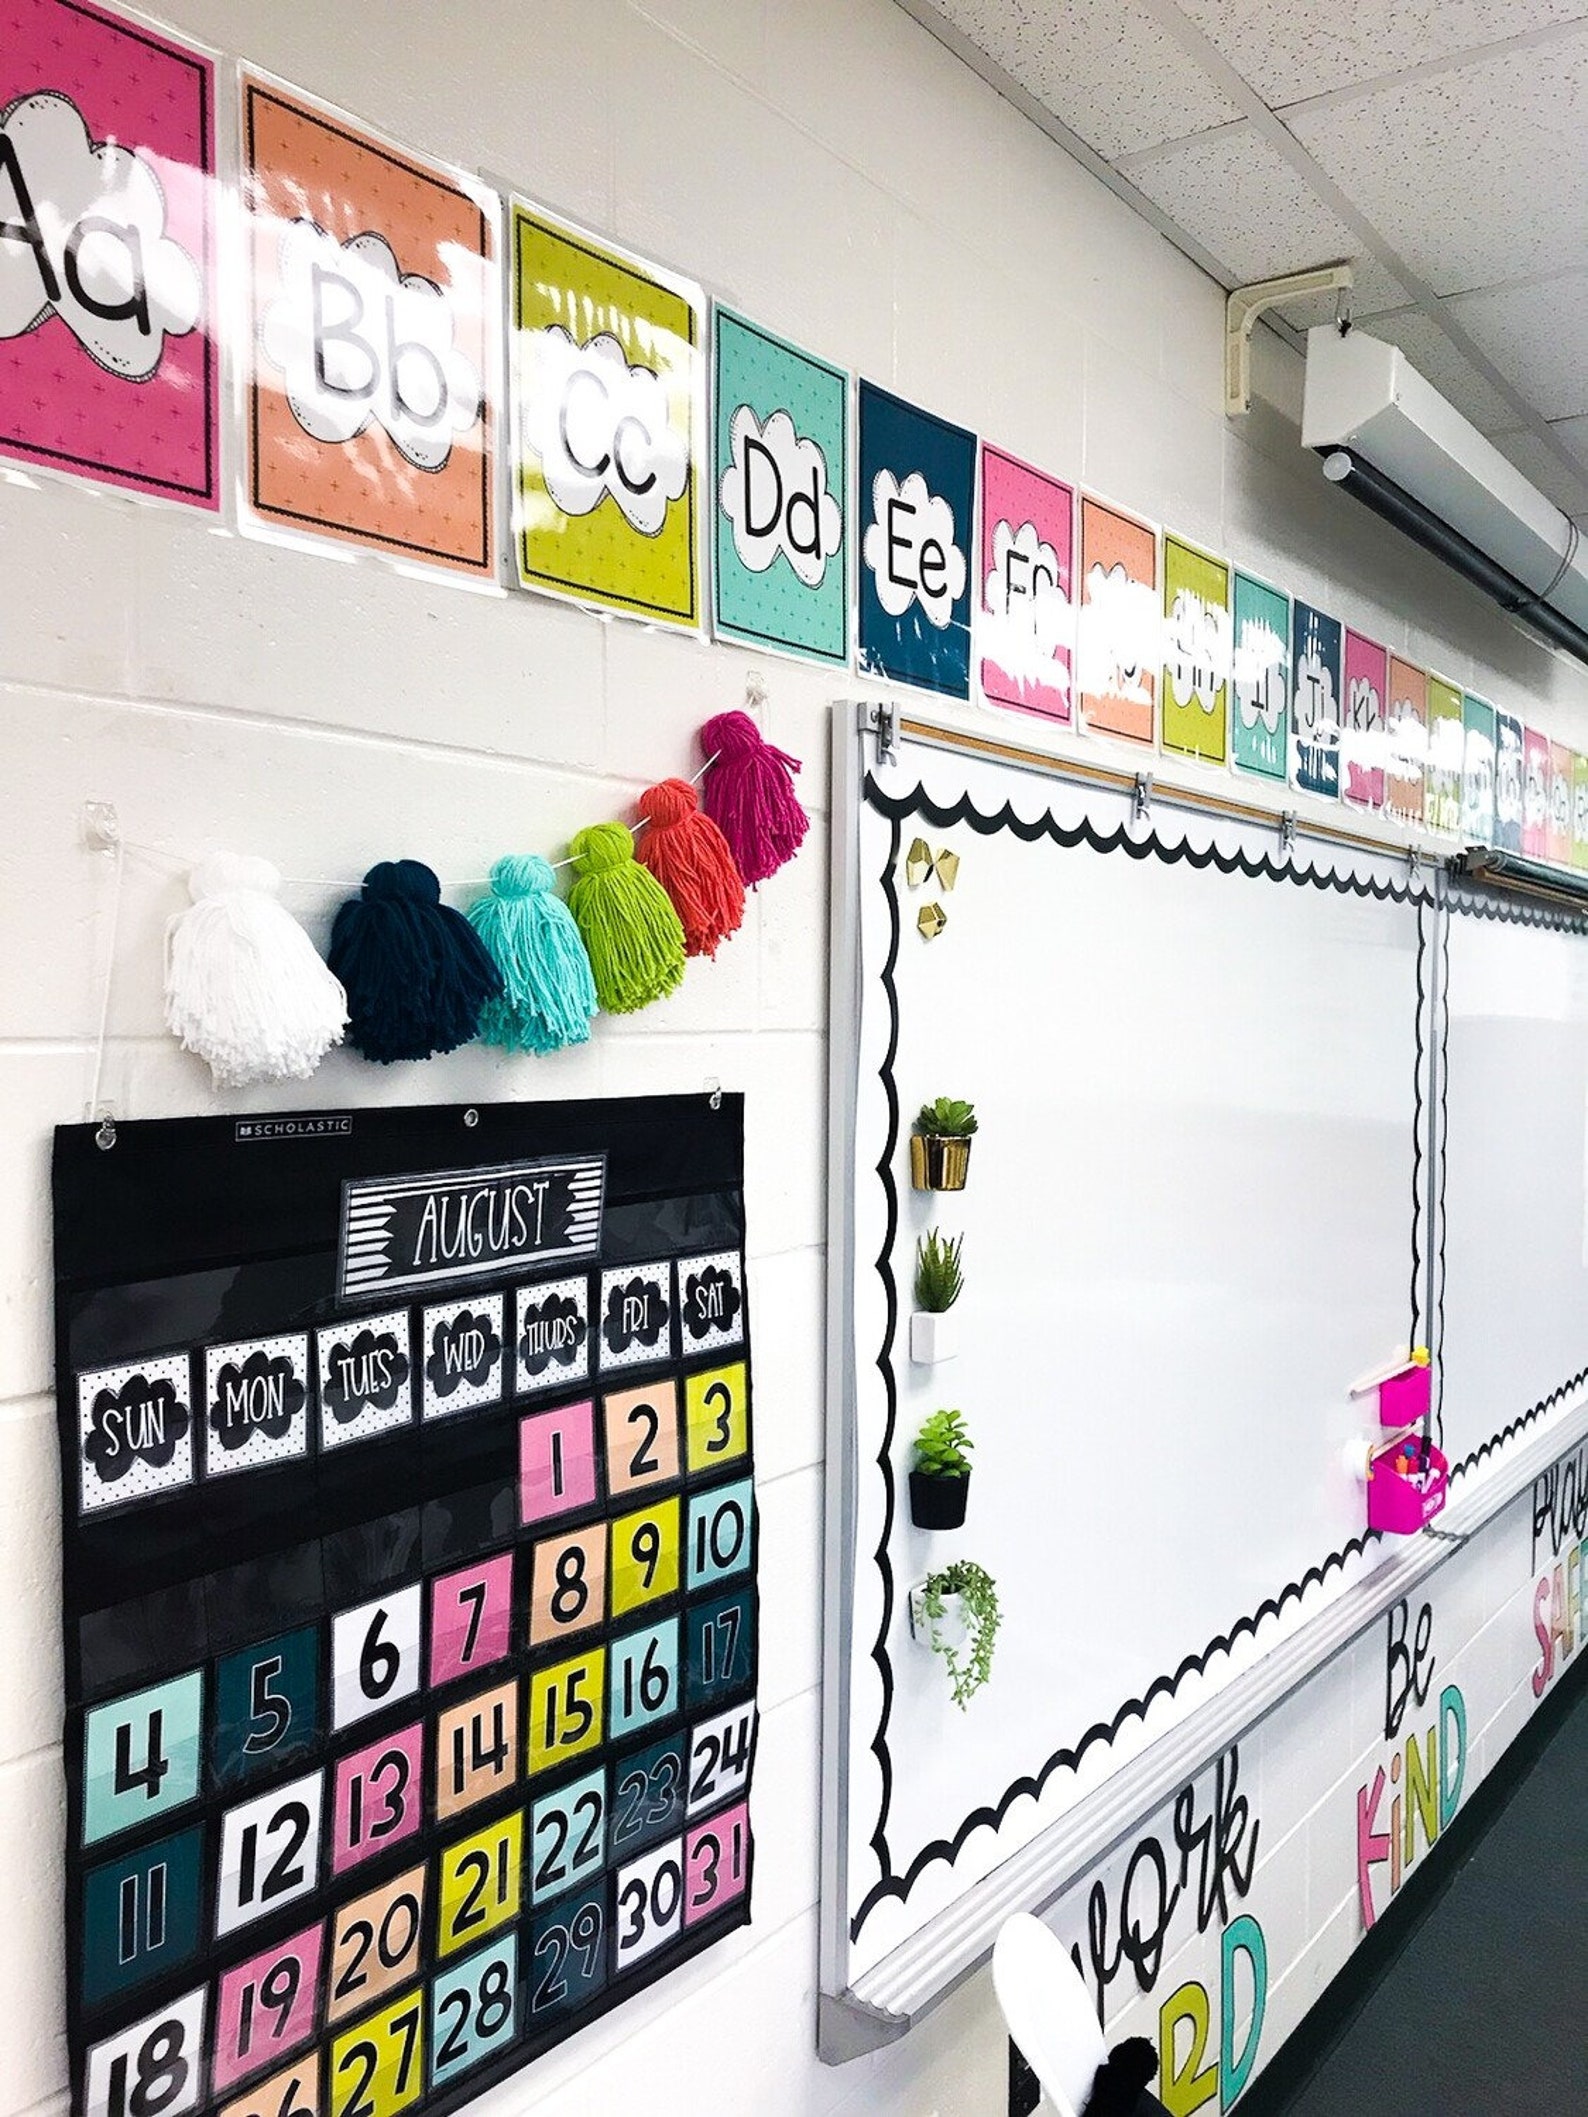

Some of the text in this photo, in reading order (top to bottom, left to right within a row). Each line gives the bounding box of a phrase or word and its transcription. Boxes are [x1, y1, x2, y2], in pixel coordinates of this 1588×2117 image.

[0, 133, 151, 336] Aa
[312, 263, 448, 428] Bb
[559, 369, 657, 496] Cc
[744, 436, 823, 561] Dd
[888, 498, 948, 599] Ee
[254, 1120, 349, 1136] SCHOLASTIC
[413, 1180, 551, 1267] AUGUST
[102, 1398, 166, 1456] SUN
[225, 1371, 286, 1427] MON
[338, 1349, 394, 1404] TUES
[442, 1327, 485, 1376] WED
[698, 1279, 725, 1318] SAT
[552, 1382, 731, 1497] 1 2 3
[112, 1498, 744, 1799] 4 5 6 7 8 9 10
[1384, 1597, 1435, 1741] Be
[119, 1606, 741, 1965] 11 12 13 14 15 16 17
[109, 2018, 186, 2117] 18
[239, 1956, 300, 2057] 19
[335, 1892, 419, 1999] 20
[450, 1837, 511, 1936] 21
[534, 1791, 602, 1891] 22
[615, 1752, 680, 1846] 23
[689, 1717, 748, 1795] 24
[335, 1821, 742, 2117] 27 28 29 30 31
